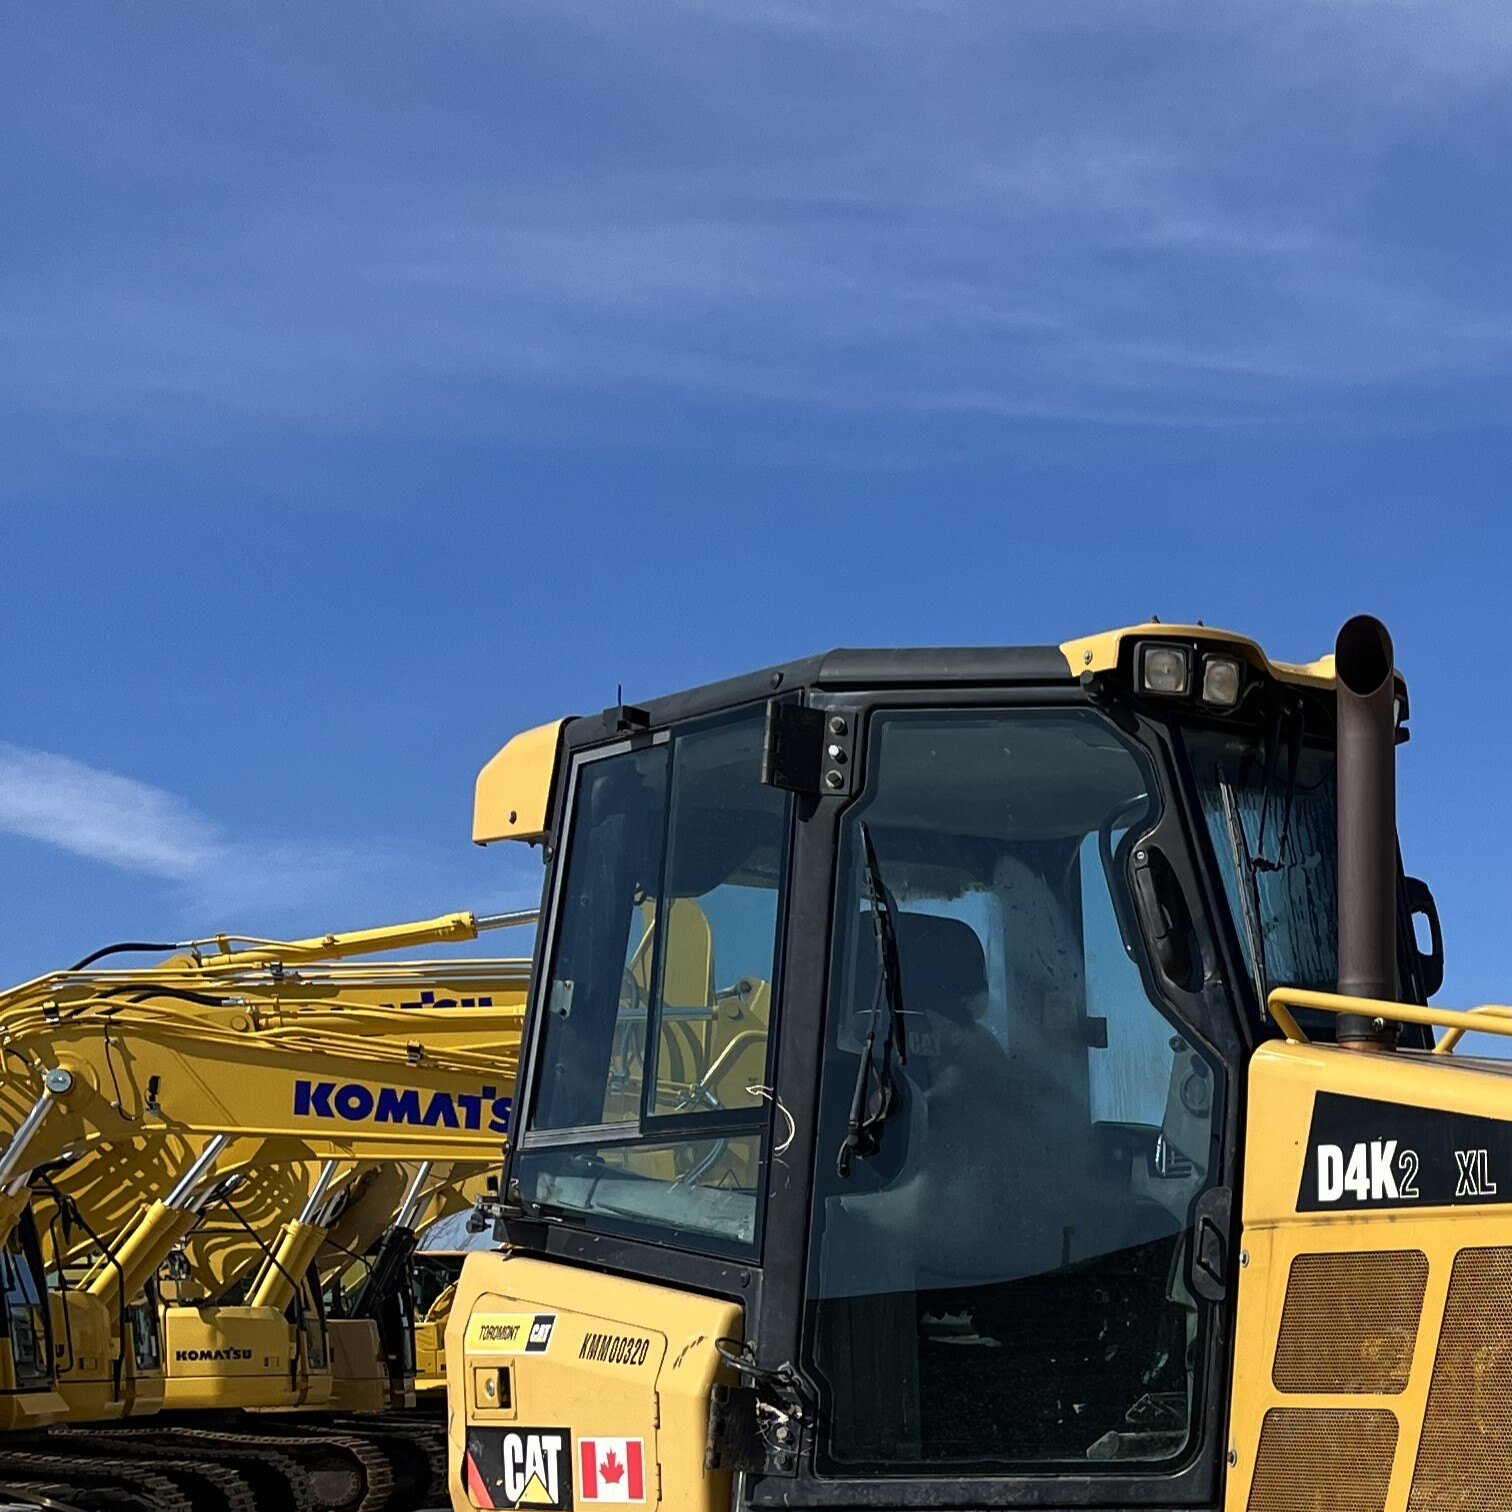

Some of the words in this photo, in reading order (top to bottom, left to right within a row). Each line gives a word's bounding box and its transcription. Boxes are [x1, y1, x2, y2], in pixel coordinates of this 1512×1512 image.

[1454, 1149, 1497, 1196] XL
[478, 1325, 521, 1341] TOROMONT
[529, 1323, 552, 1343] CAT
[578, 1332, 650, 1366] KMM00320
[175, 1346, 252, 1361] KOMATSU
[503, 1433, 562, 1504] CAT
